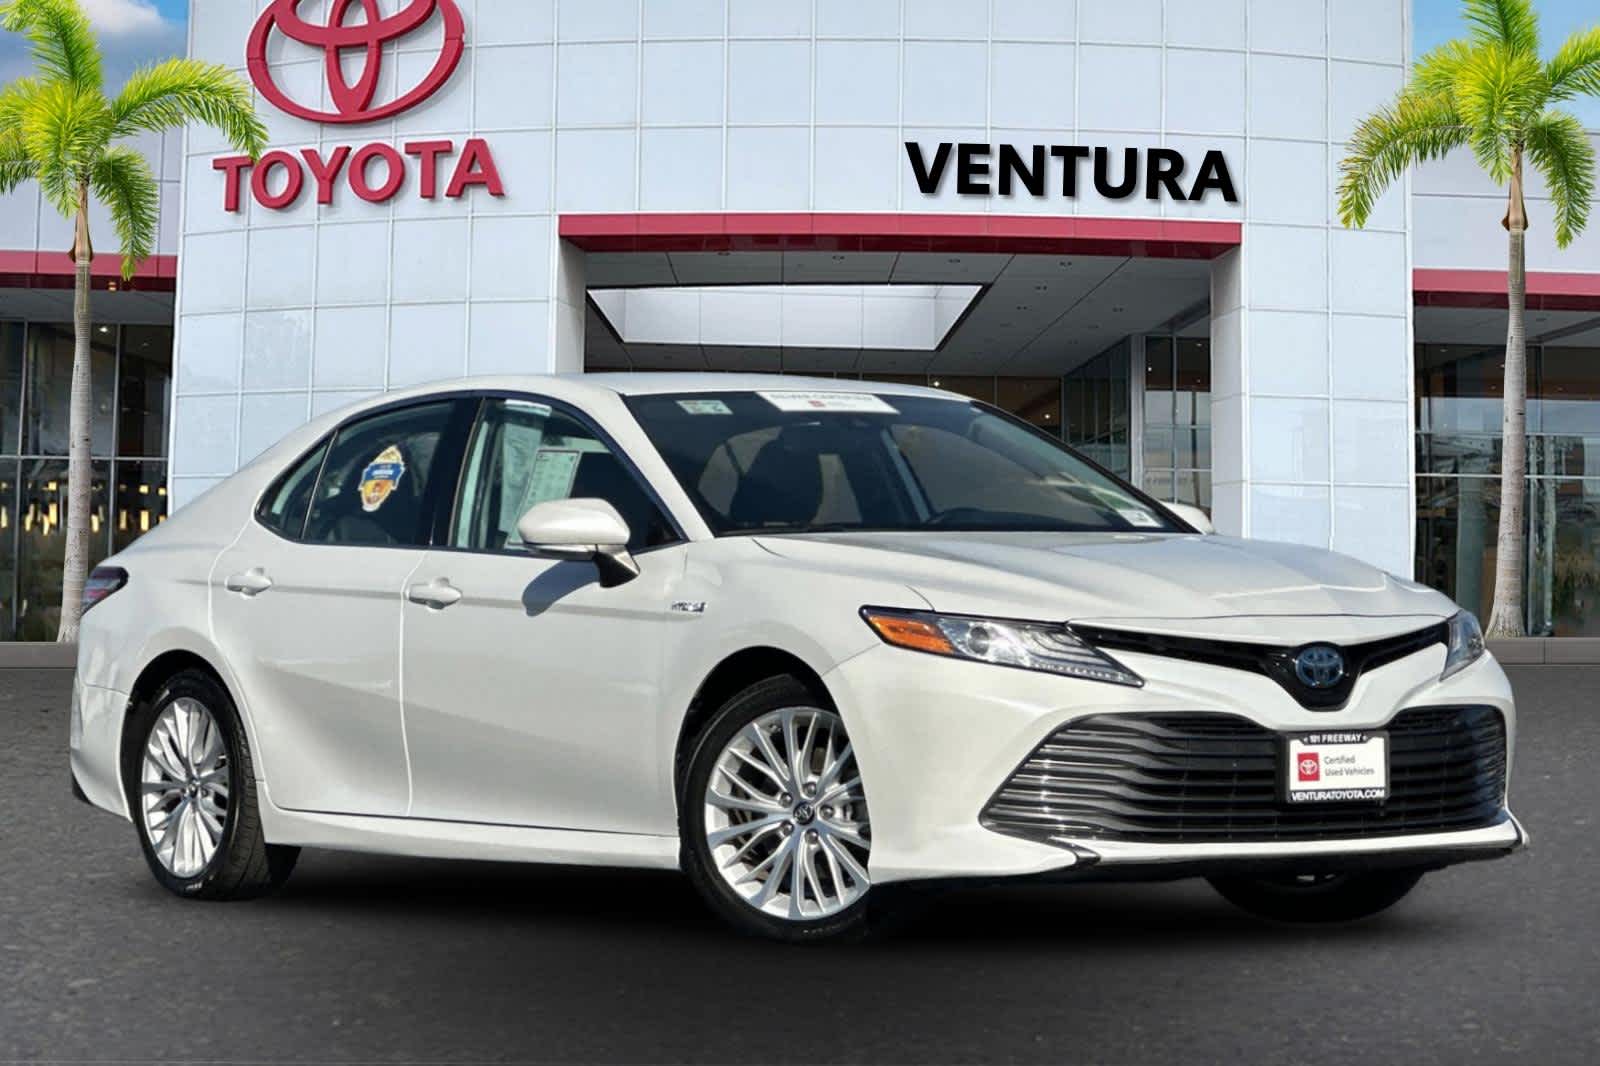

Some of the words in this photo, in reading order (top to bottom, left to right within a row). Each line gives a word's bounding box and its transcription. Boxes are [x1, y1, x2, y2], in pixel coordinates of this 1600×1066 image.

[212, 138, 505, 212] TOYOTA
[904, 141, 1239, 203] VENTURA
[1322, 733, 1362, 743] FREEWAY
[1323, 755, 1356, 765] Certified
[1325, 768, 1344, 776] Used
[1345, 767, 1375, 776] Vehicles
[1291, 789, 1385, 801] VENTURATOYOTA.COM
